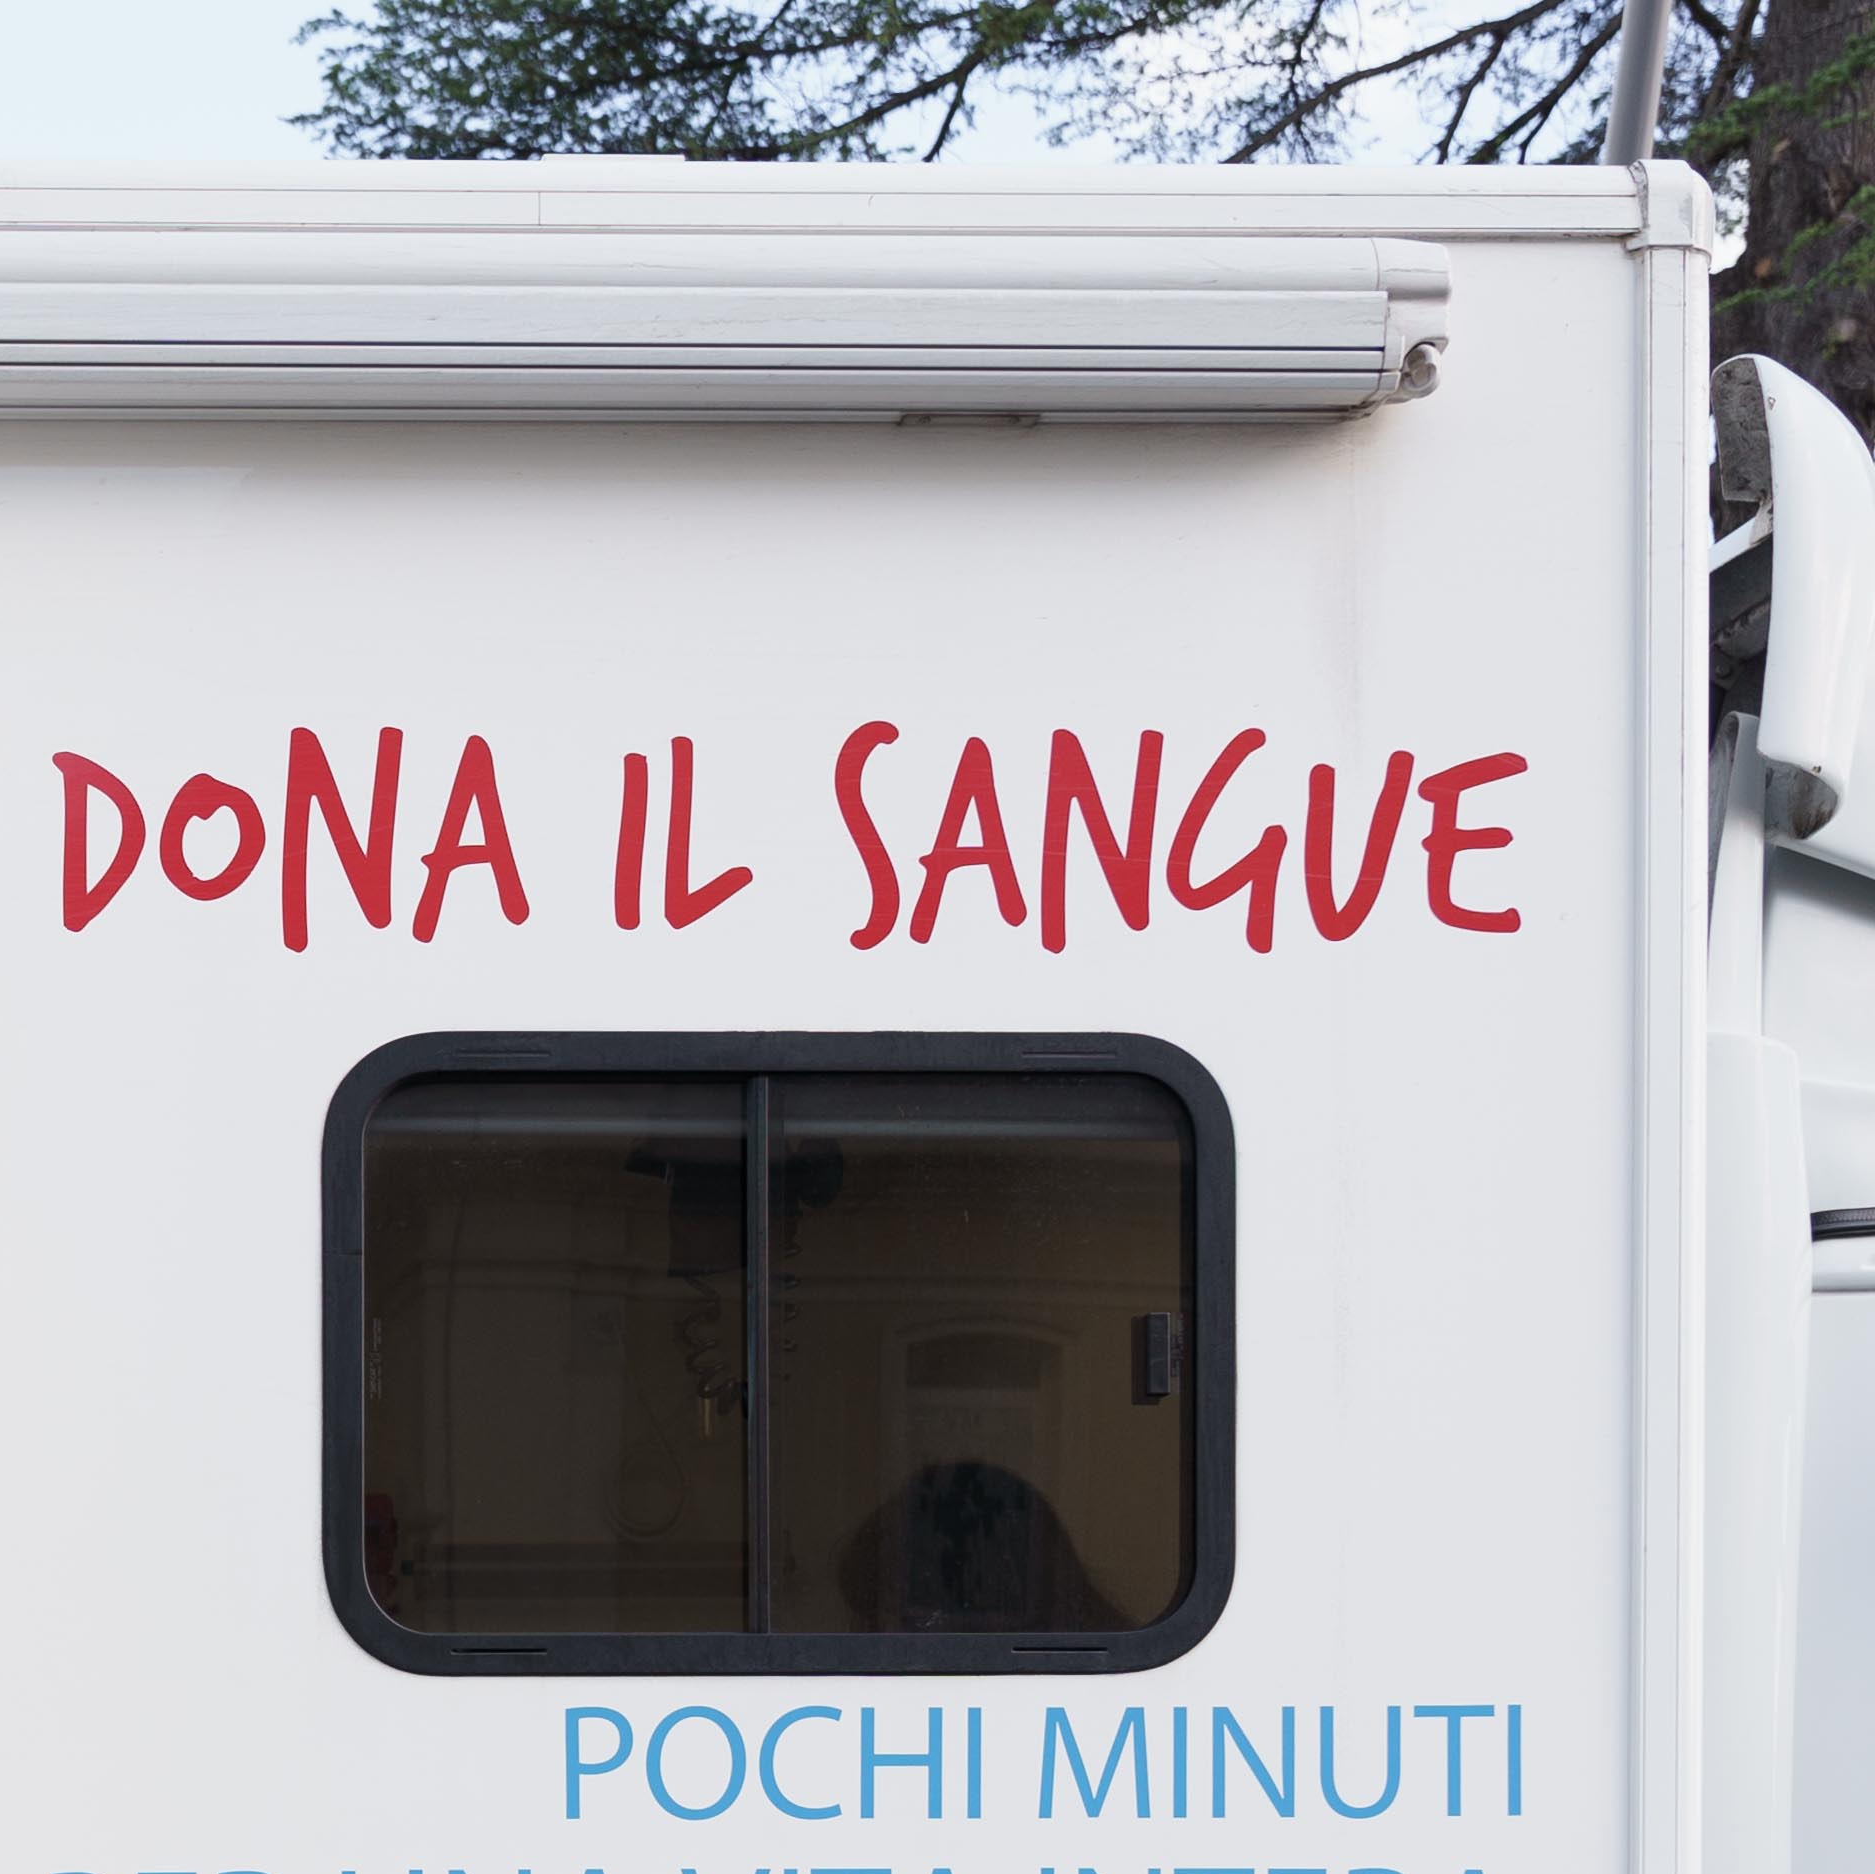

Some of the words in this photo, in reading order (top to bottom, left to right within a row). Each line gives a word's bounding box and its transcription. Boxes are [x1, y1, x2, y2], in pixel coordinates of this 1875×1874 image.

[55, 728, 530, 953] DONA
[615, 737, 753, 931] IL
[836, 721, 1529, 955] SANGUE
[564, 1705, 984, 1822] POCHI
[1038, 1703, 1524, 1820] MINUTI
